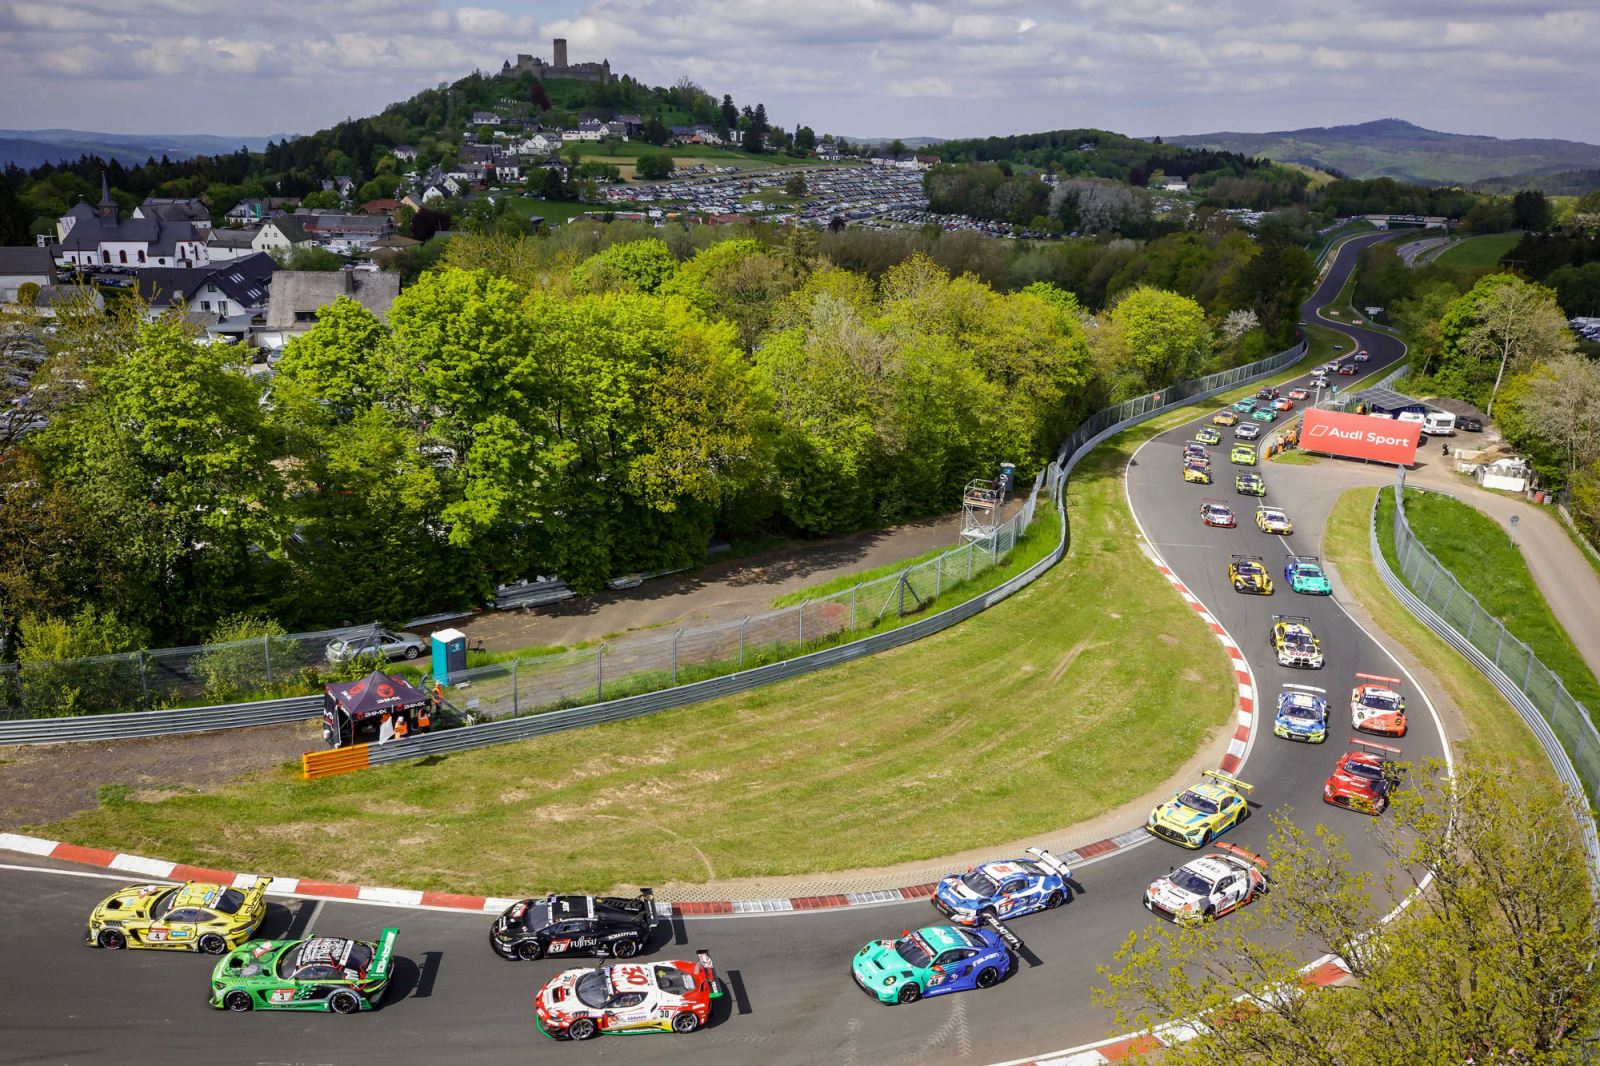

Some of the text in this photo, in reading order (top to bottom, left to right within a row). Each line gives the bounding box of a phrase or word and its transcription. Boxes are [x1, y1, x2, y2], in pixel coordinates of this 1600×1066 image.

[1328, 427, 1409, 447] Audi Sport
[570, 936, 597, 948] FUJITSU
[972, 952, 999, 967] FALKEN
[622, 965, 649, 985] 30
[931, 978, 940, 986] 44
[660, 1010, 670, 1018] 30
